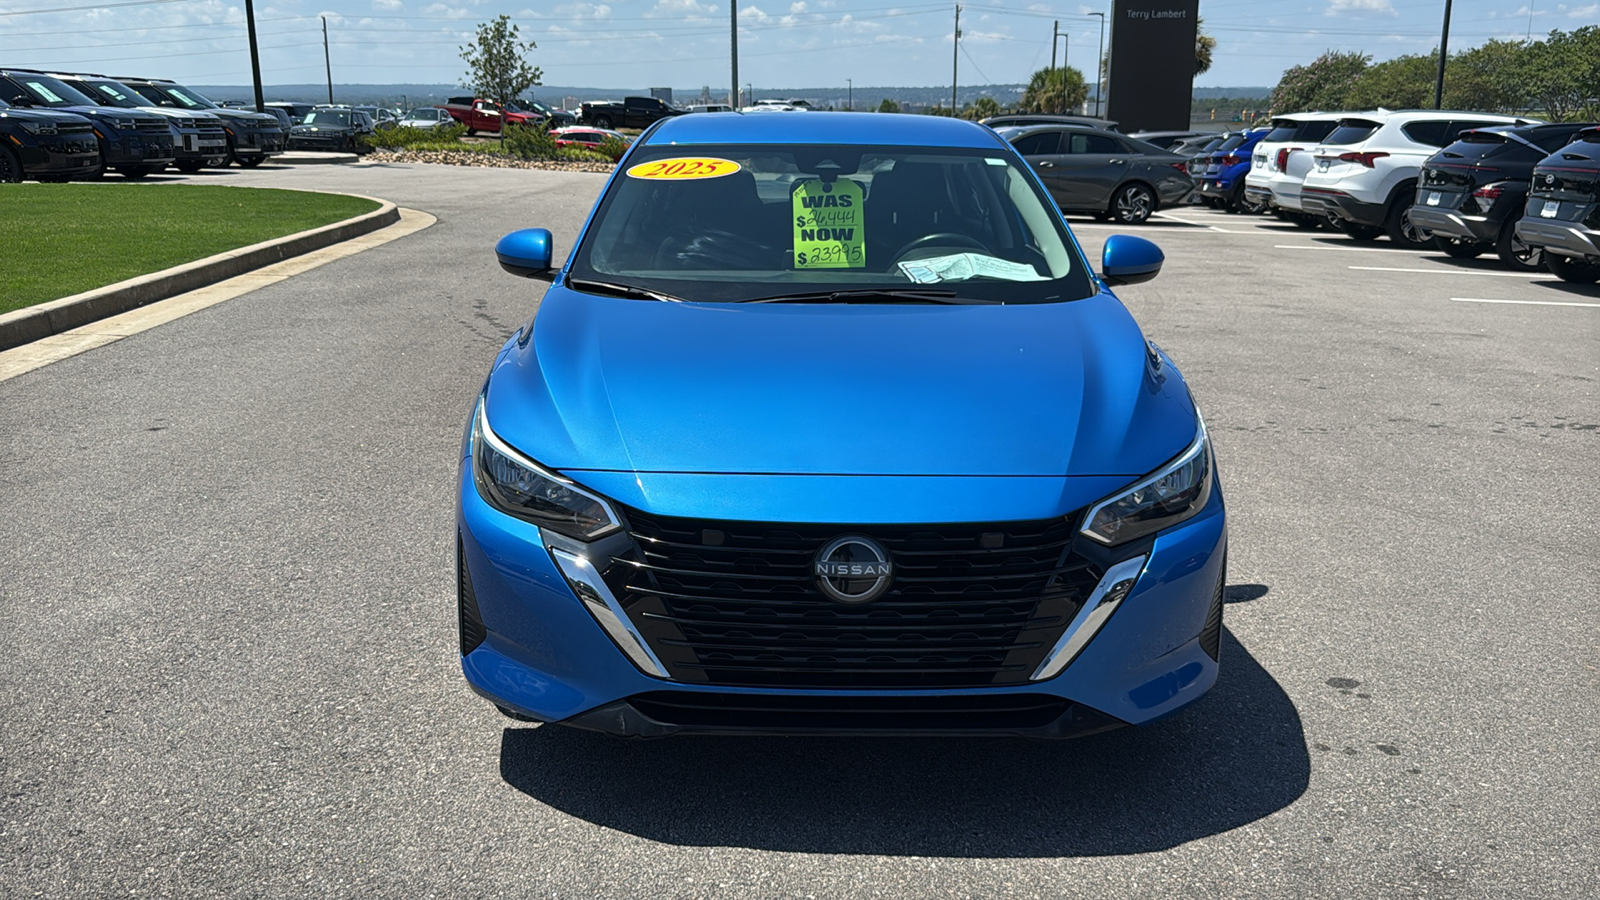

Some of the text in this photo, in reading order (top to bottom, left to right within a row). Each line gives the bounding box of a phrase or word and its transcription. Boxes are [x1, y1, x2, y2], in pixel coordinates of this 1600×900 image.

[1127, 10, 1186, 20] Terry Lambert
[644, 162, 723, 176] 2025
[801, 194, 852, 208] WAS
[801, 228, 854, 241] NOW
[817, 564, 889, 574] NISSAN
